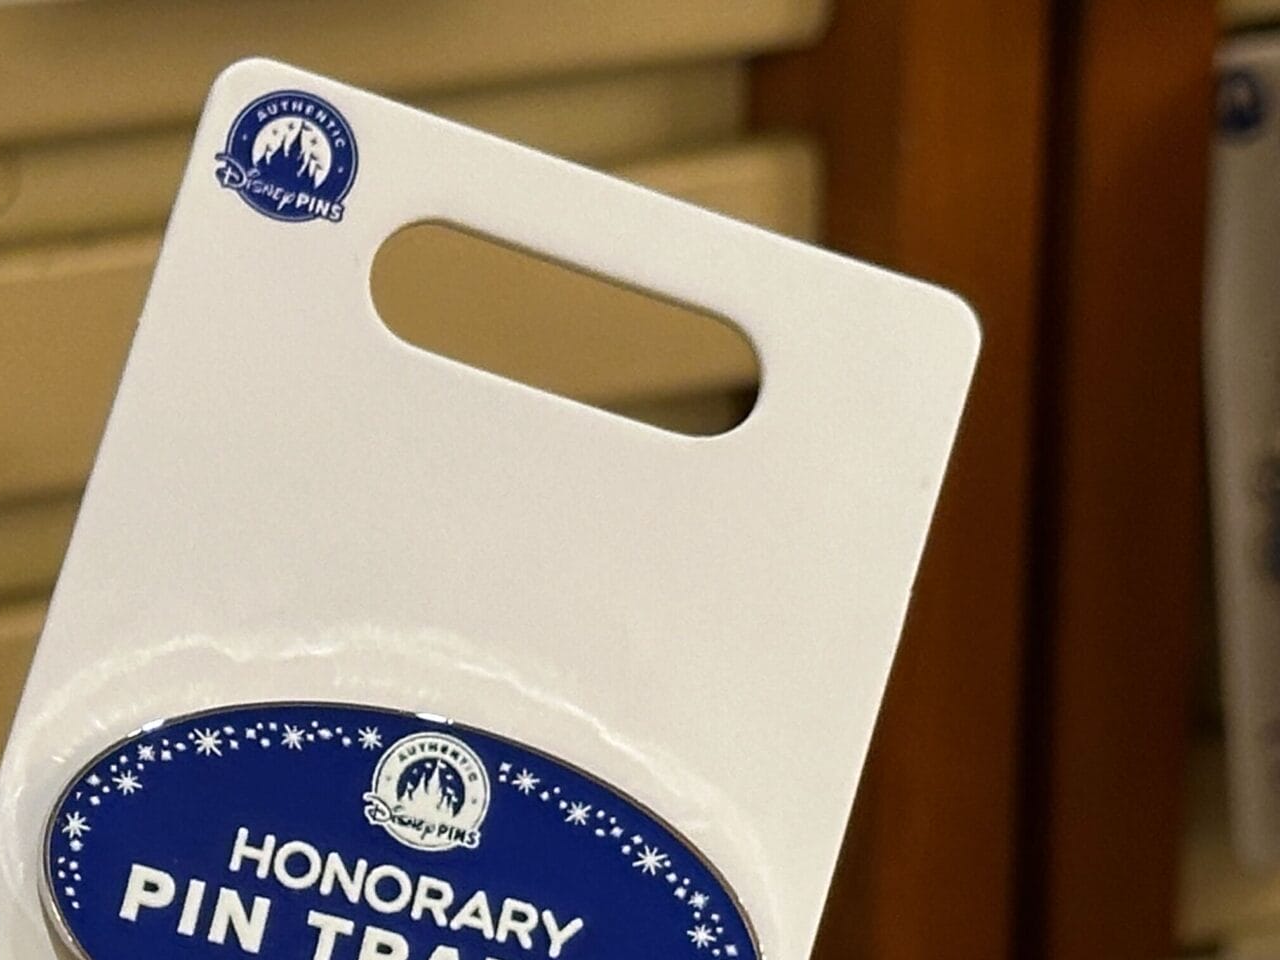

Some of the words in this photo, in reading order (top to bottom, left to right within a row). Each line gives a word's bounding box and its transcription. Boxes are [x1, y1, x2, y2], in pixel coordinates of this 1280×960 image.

[256, 101, 346, 149] AUTHENTIC
[295, 193, 343, 220] PINS
[398, 742, 478, 783] AUTHENTIC
[119, 863, 272, 955] PIN
[230, 828, 584, 960] HONORARY
